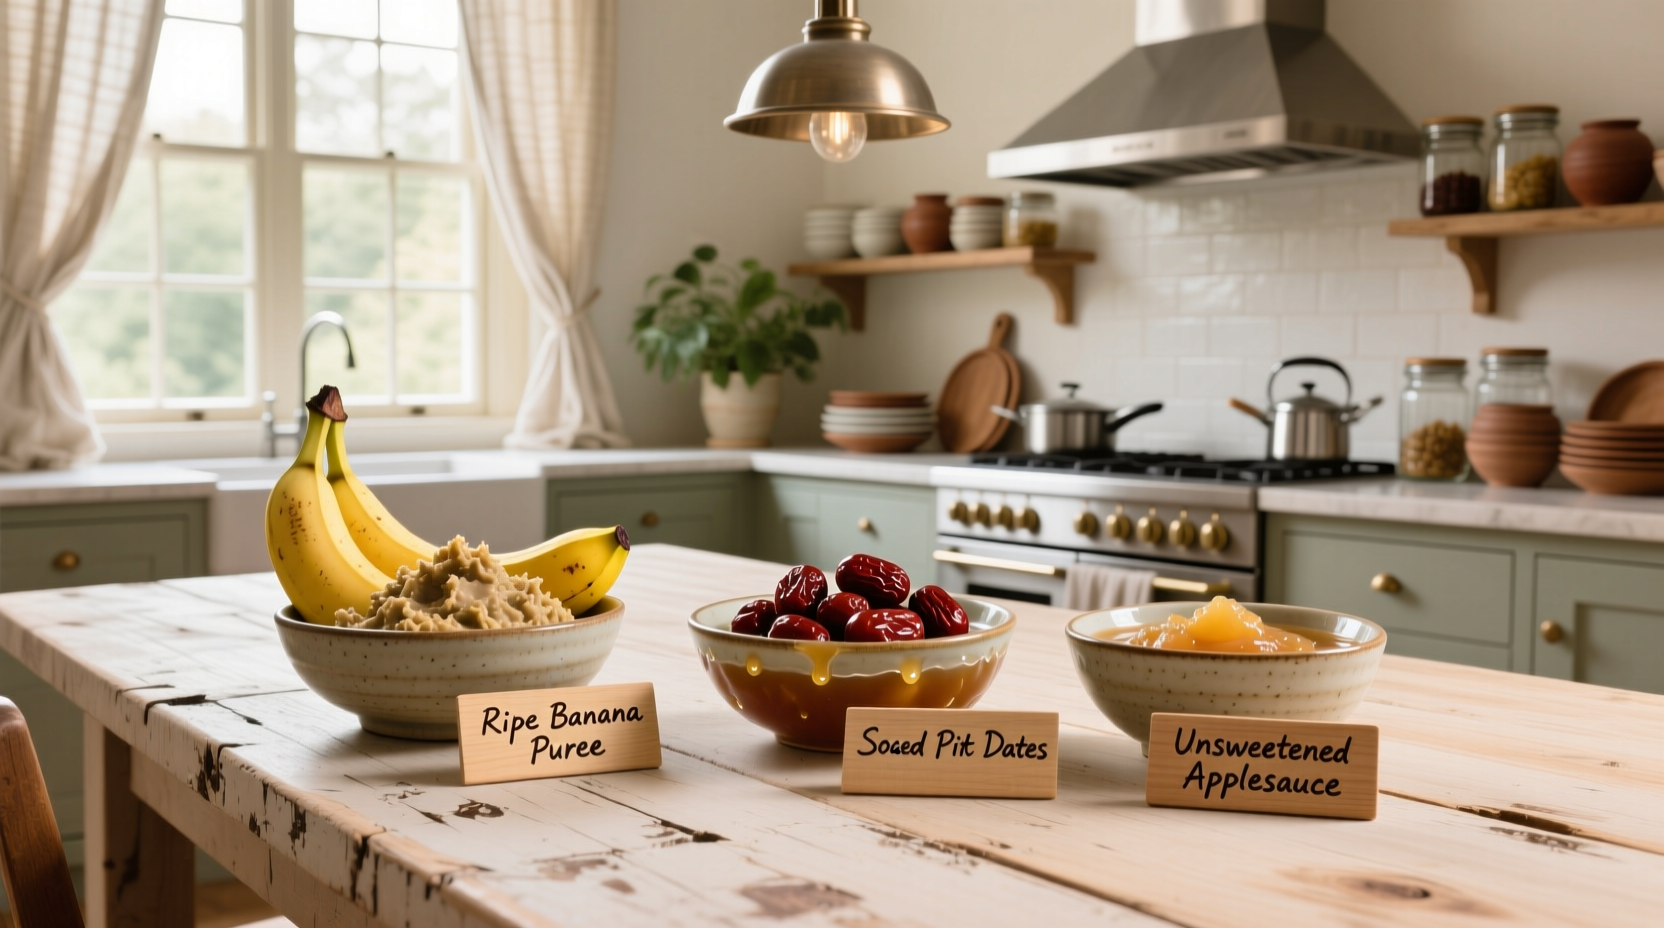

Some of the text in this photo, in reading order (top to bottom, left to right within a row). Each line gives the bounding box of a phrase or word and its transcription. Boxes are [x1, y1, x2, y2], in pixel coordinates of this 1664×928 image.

[481, 701, 644, 745] Ripe Banana
[530, 735, 606, 765] Puree
[935, 729, 975, 759] Pit
[983, 729, 1048, 760] Dates
[1174, 727, 1353, 764] Unsweetened
[1182, 760, 1342, 799] Applesauce
